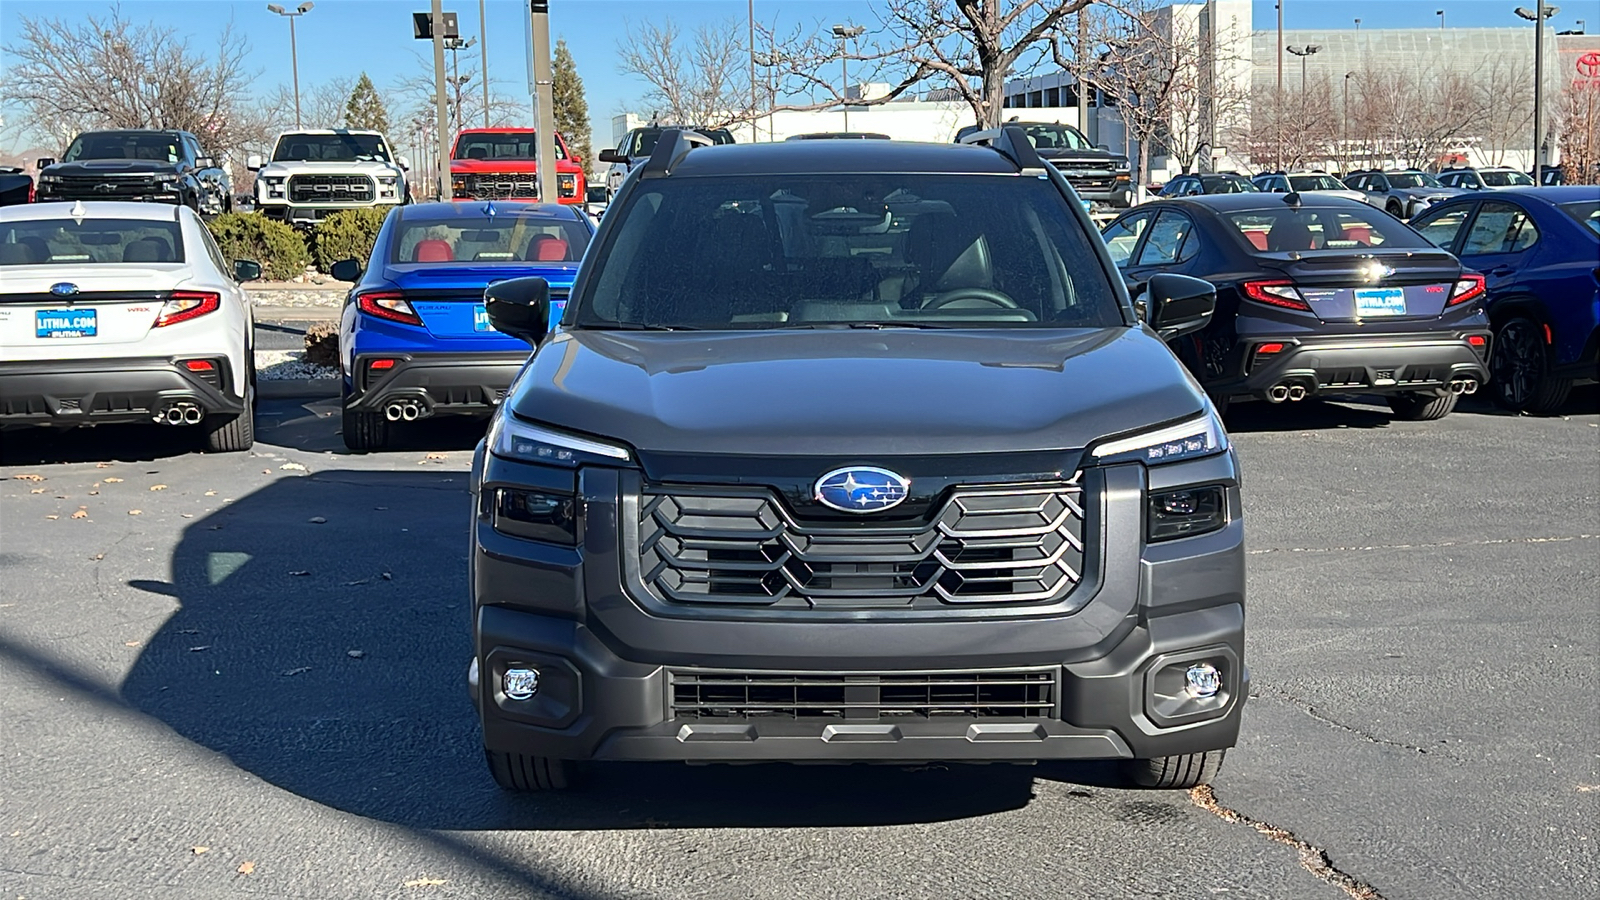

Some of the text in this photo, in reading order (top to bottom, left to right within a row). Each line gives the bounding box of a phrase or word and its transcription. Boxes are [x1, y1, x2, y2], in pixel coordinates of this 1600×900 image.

[295, 184, 369, 192] FORD
[475, 182, 539, 190] FOR
[37, 317, 96, 330] LITHIA.COM
